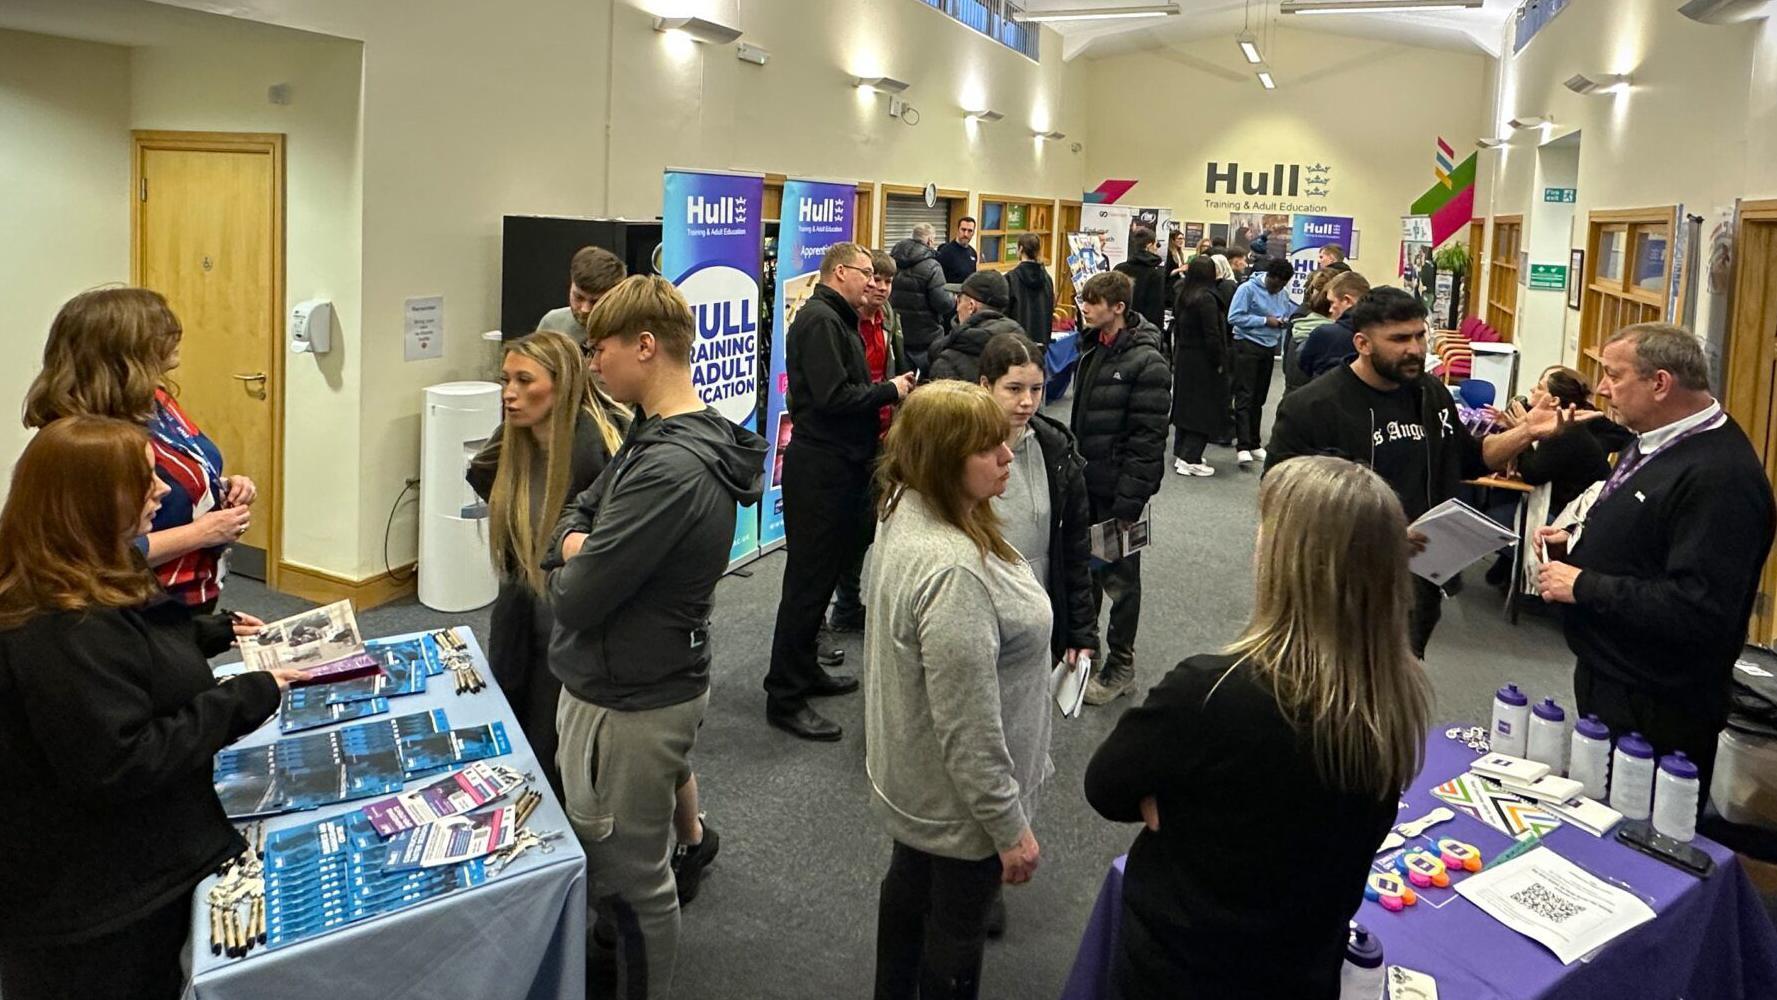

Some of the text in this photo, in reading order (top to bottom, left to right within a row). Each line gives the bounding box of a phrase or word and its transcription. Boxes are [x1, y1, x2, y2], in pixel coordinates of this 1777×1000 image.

[1206, 162, 1299, 196] Hull
[687, 196, 734, 224] Hull
[799, 198, 834, 222] Hull
[1205, 200, 1327, 213] Training & Adult Education
[687, 229, 706, 237] Training
[724, 227, 746, 235] Education
[1304, 223, 1332, 234] Hull
[692, 355, 754, 387] ADULT
